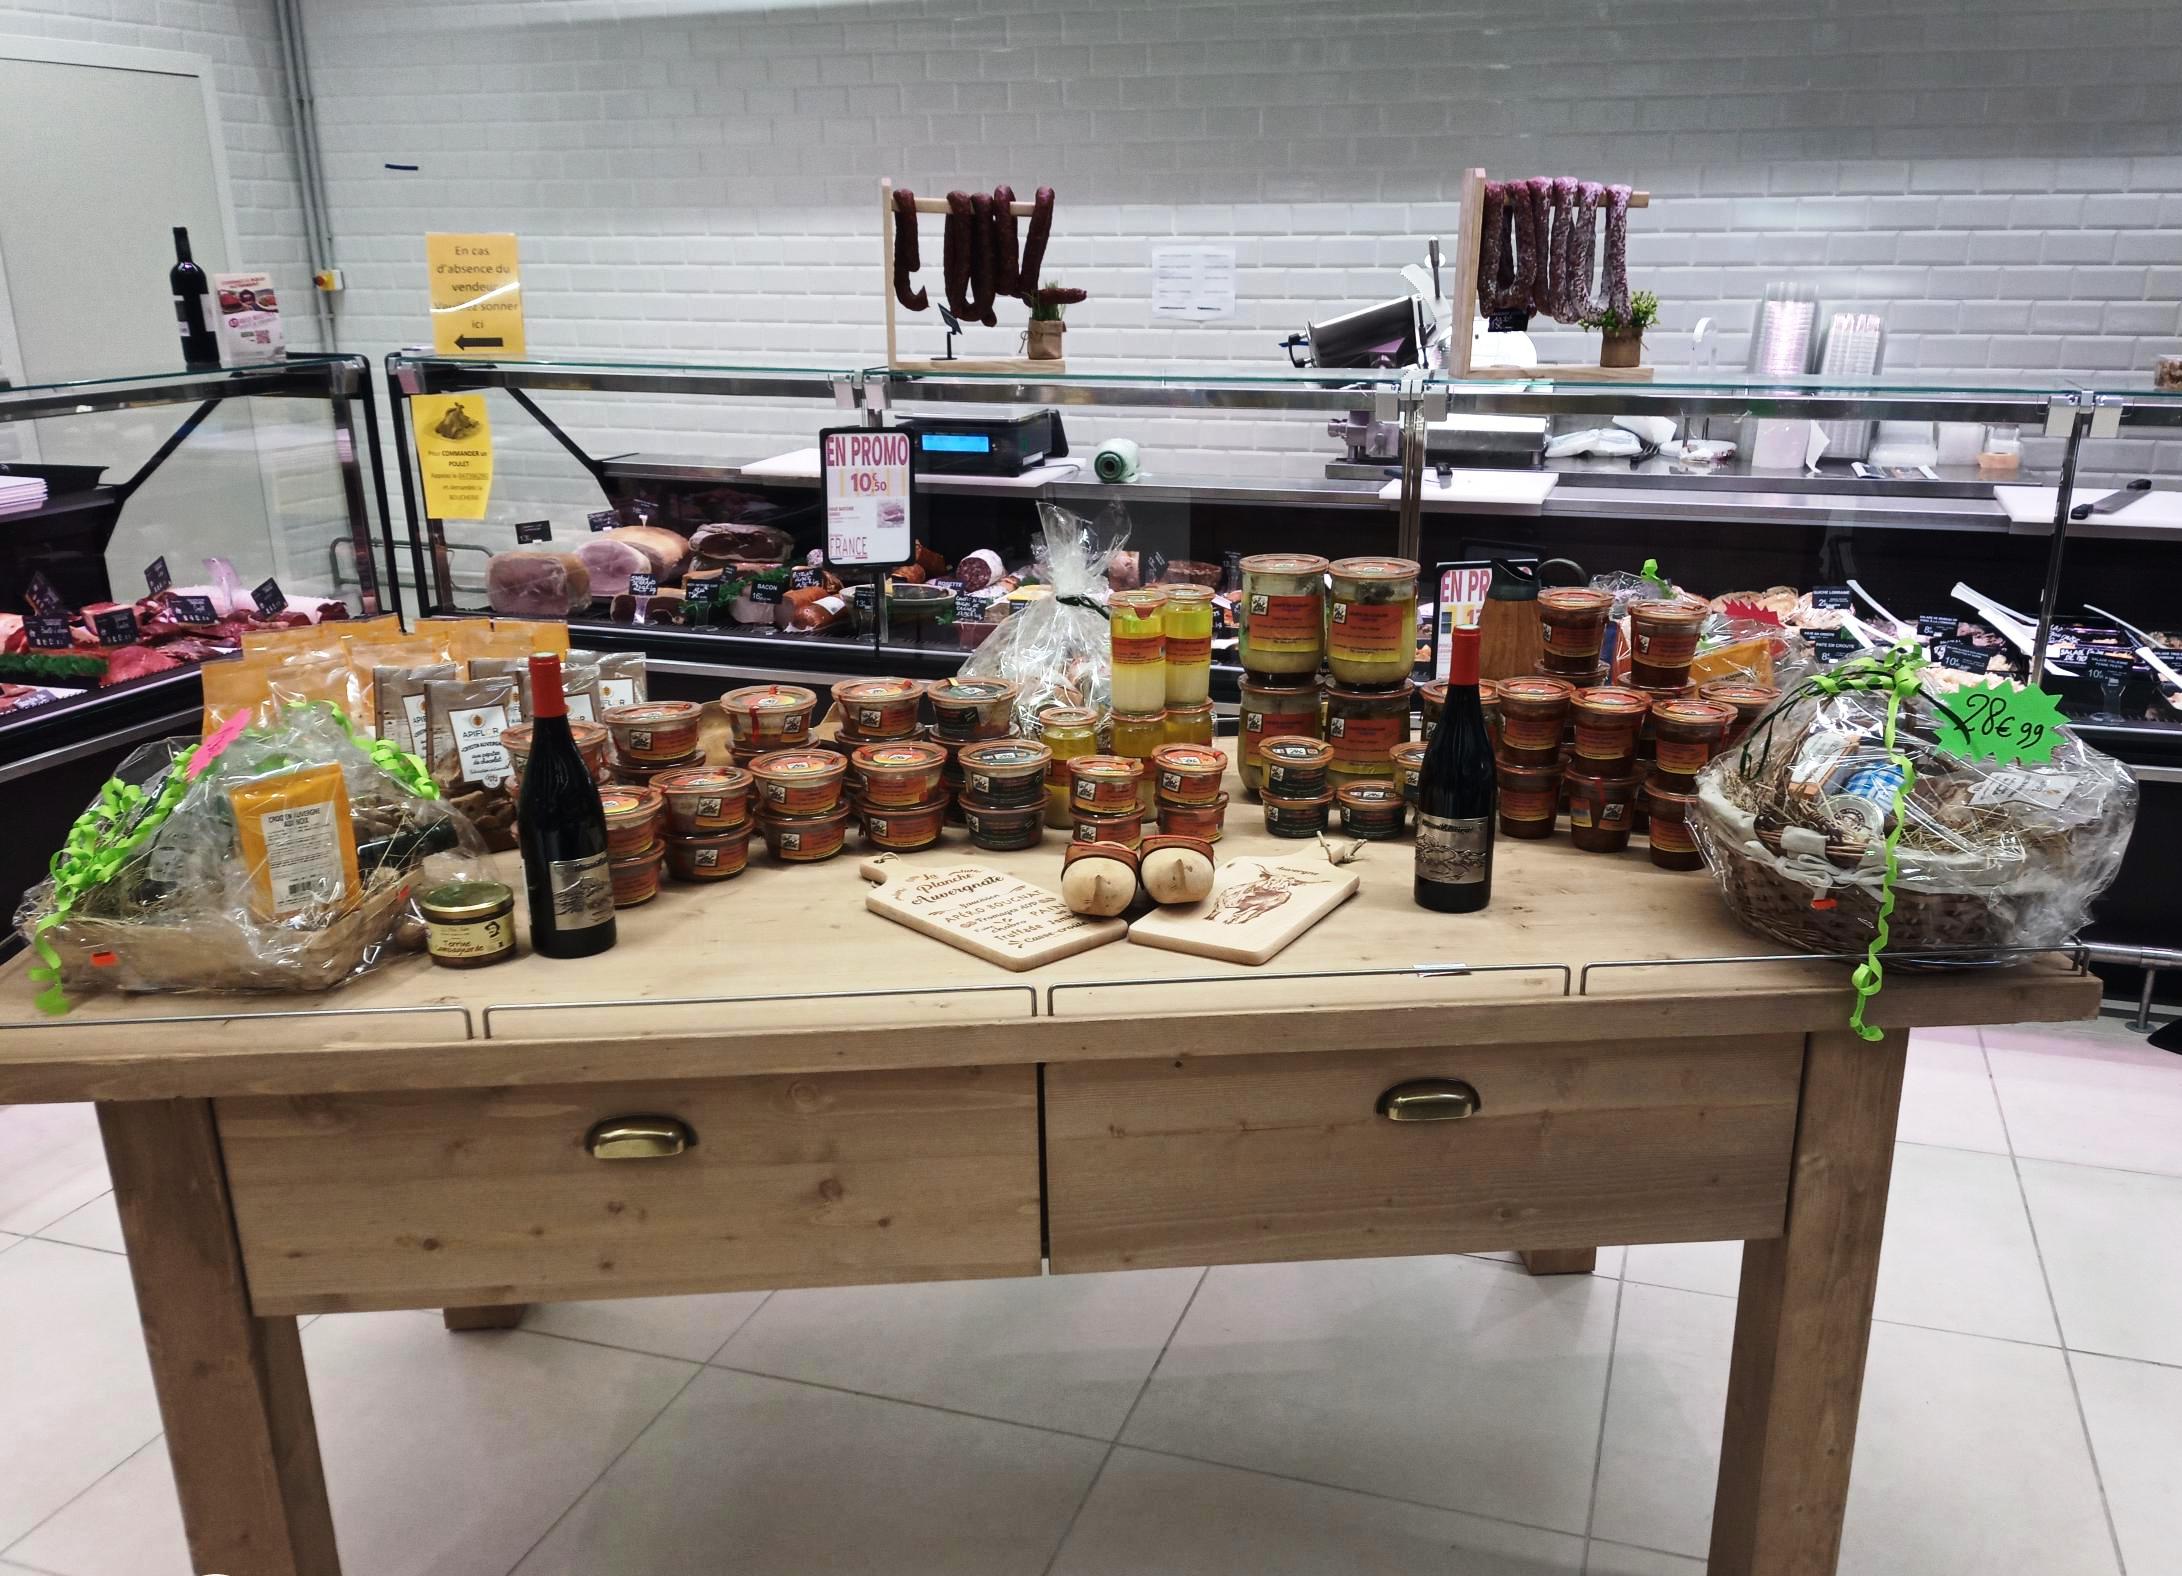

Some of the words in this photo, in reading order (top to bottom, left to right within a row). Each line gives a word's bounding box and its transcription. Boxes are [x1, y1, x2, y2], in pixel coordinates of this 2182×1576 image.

[455, 246, 469, 256] En
[472, 247, 490, 256] cas
[436, 264, 494, 274] d'absence
[496, 264, 511, 274] du
[480, 303, 518, 312] sonner
[471, 320, 484, 329] ici
[825, 435, 846, 467] EN
[851, 434, 909, 467] PROMO
[448, 460, 470, 468] POULET
[830, 536, 868, 558] FRANCE
[757, 583, 778, 591] BACON
[1441, 570, 1464, 603] EN
[462, 727, 500, 738] APIFLOR
[916, 871, 974, 894] Planche
[911, 875, 1005, 905] Auvergnate
[987, 890, 1044, 910] BOUGNAT
[1029, 903, 1068, 917] PAIN
